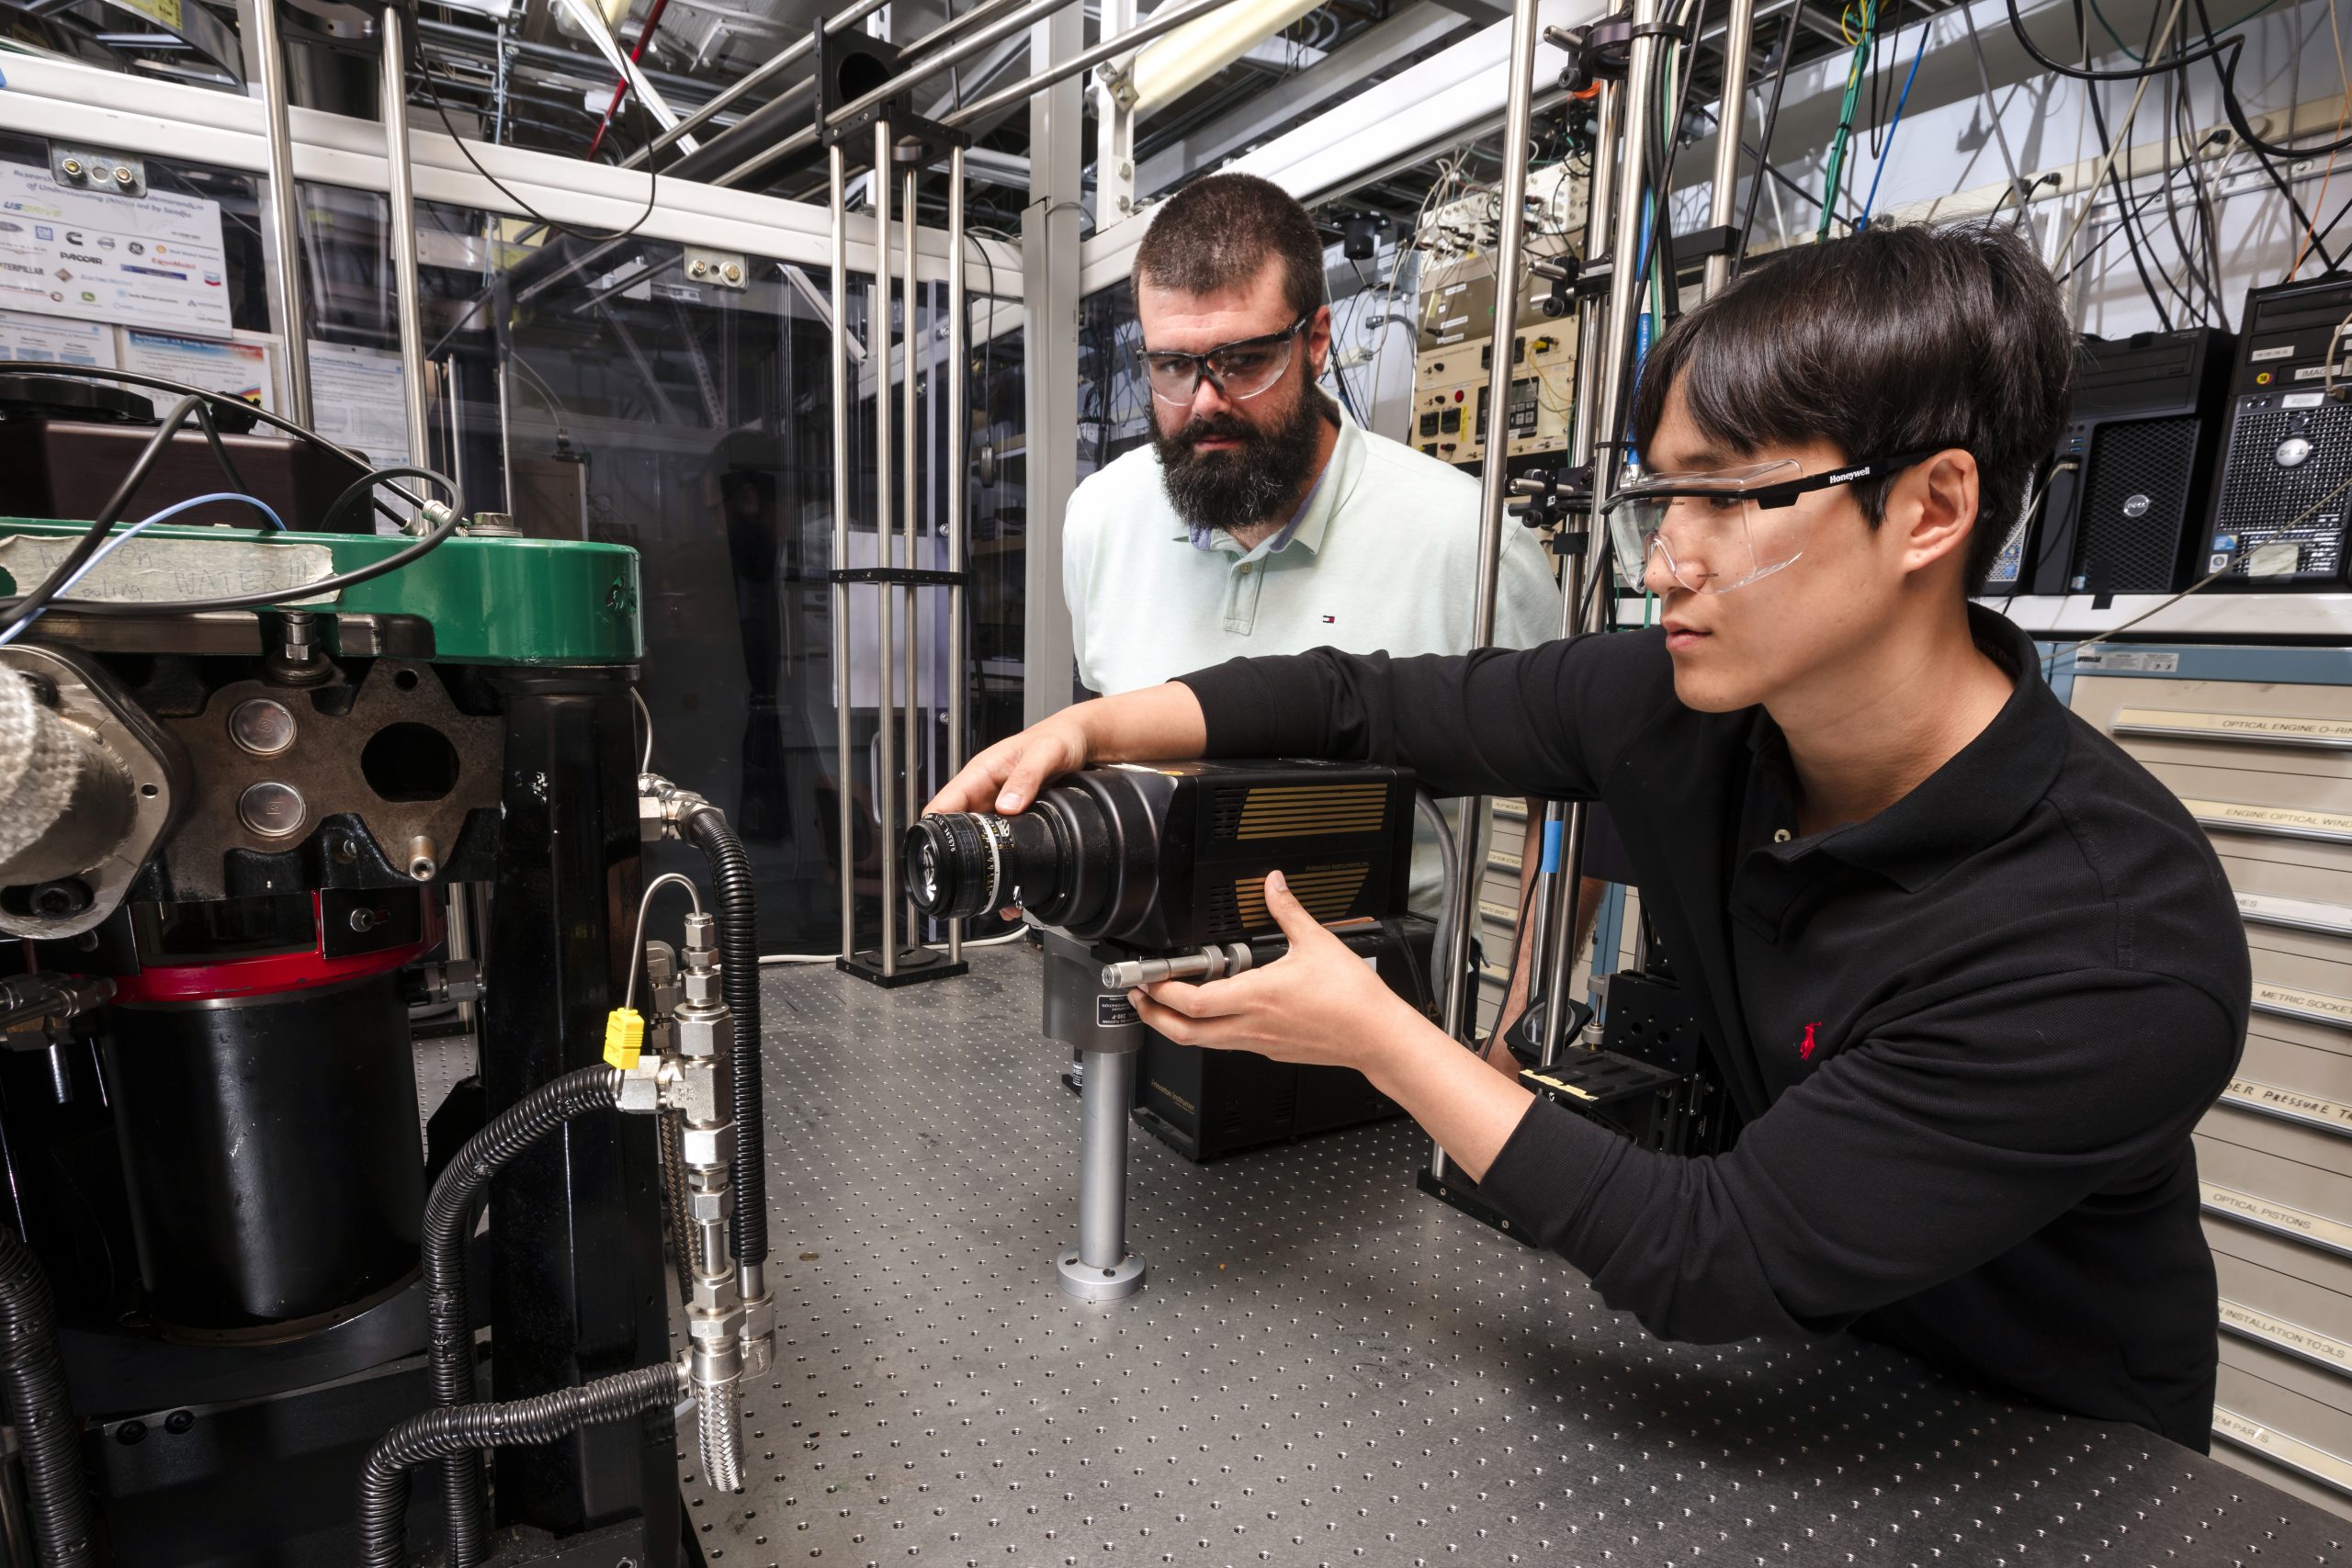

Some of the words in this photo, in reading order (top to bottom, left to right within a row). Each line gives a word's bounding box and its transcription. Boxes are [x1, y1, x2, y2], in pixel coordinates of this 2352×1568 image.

[1829, 467, 1871, 484] Honeywell
[2222, 720, 2267, 729] OPTICAL
[2271, 723, 2316, 733] ENGINE
[2225, 808, 2267, 819] ENGINE
[2270, 812, 2317, 825] OPTICAL
[2260, 990, 2305, 1005] METRIC
[2263, 1090, 2330, 1114] PRESSURE
[2213, 1193, 2258, 1213] OPTICAL
[2261, 1208, 2312, 1230] PISTONS
[2225, 1309, 2303, 1344] INSTALLATION
[2306, 1337, 2346, 1359] TOOLS
